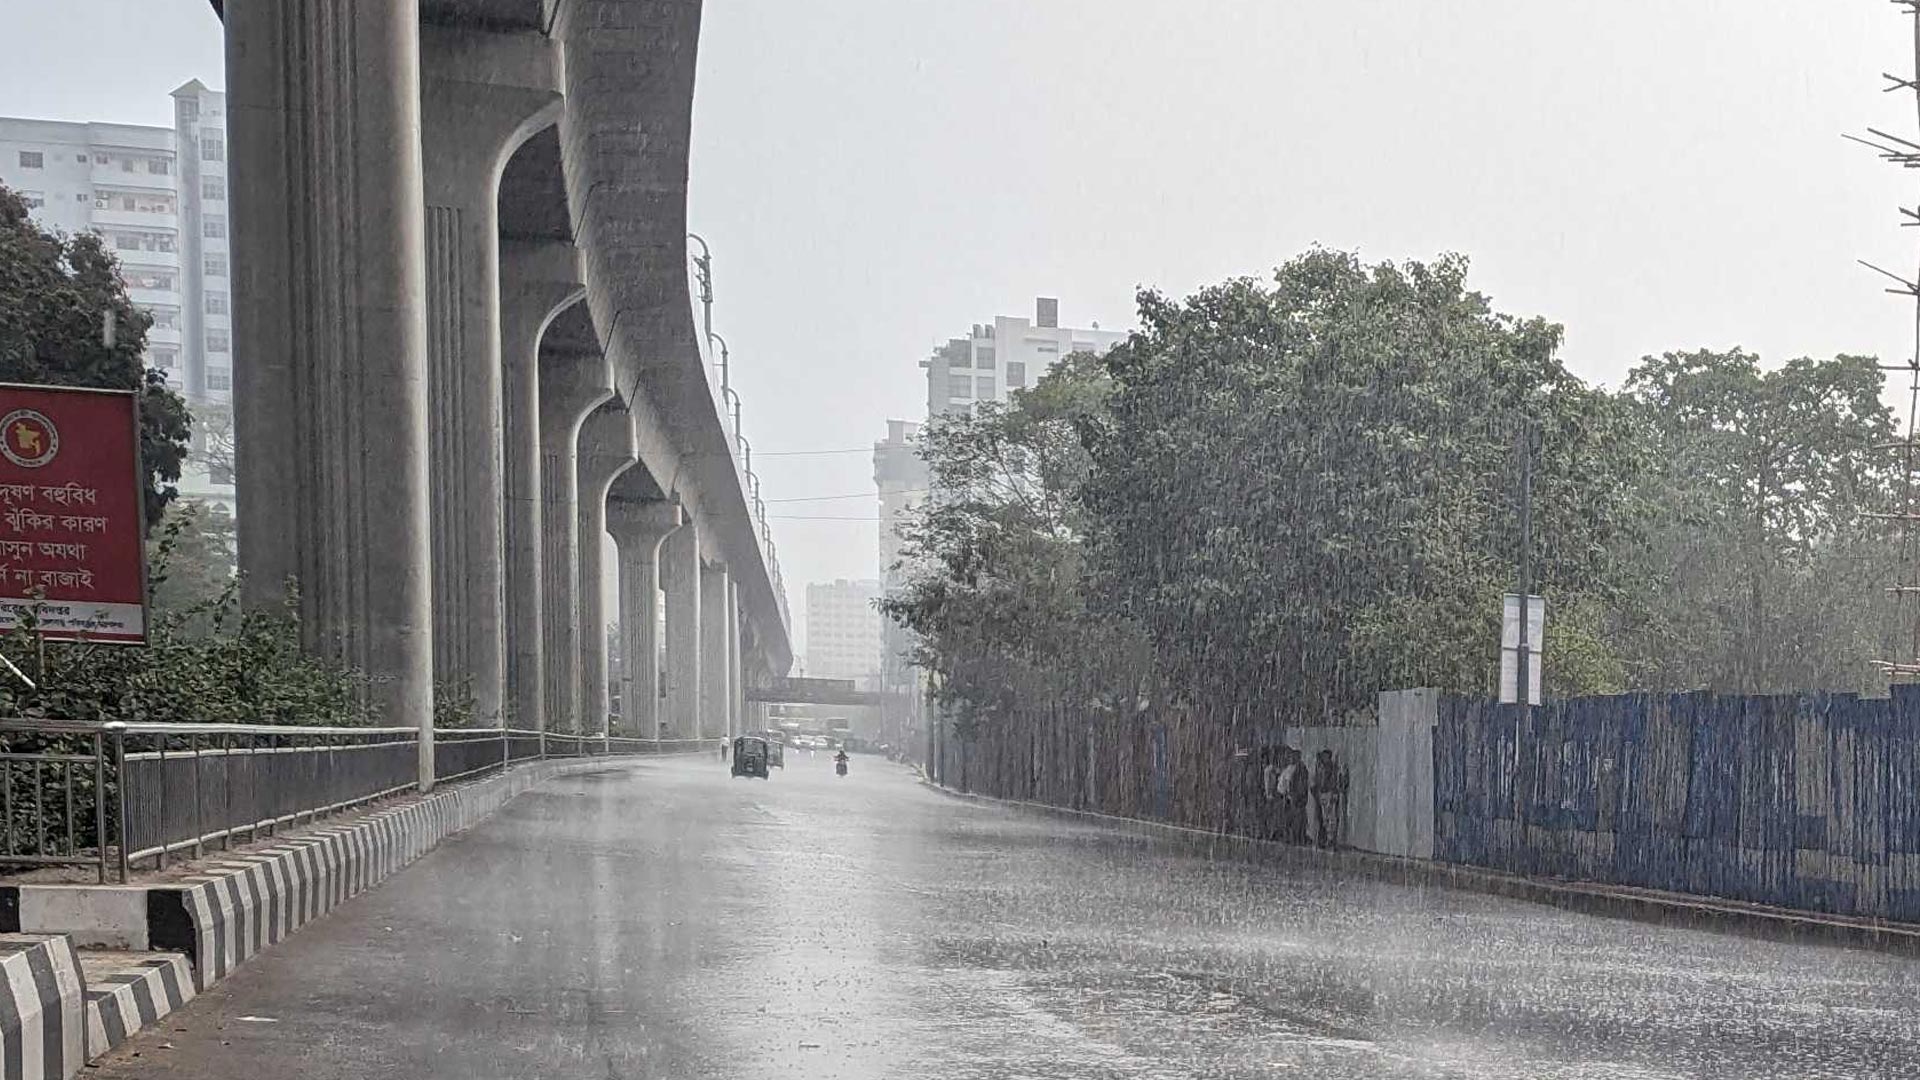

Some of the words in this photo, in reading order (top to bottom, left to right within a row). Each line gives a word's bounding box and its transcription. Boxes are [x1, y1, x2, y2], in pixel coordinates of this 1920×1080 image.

[39, 482, 97, 506] বহুবিধ
[4, 507, 55, 532] ঝুঁকির
[60, 515, 109, 533] কারণ
[0, 541, 34, 561] সুন
[37, 543, 87, 560] অযথা
[13, 569, 34, 586] না
[39, 567, 95, 590] বাজাই
